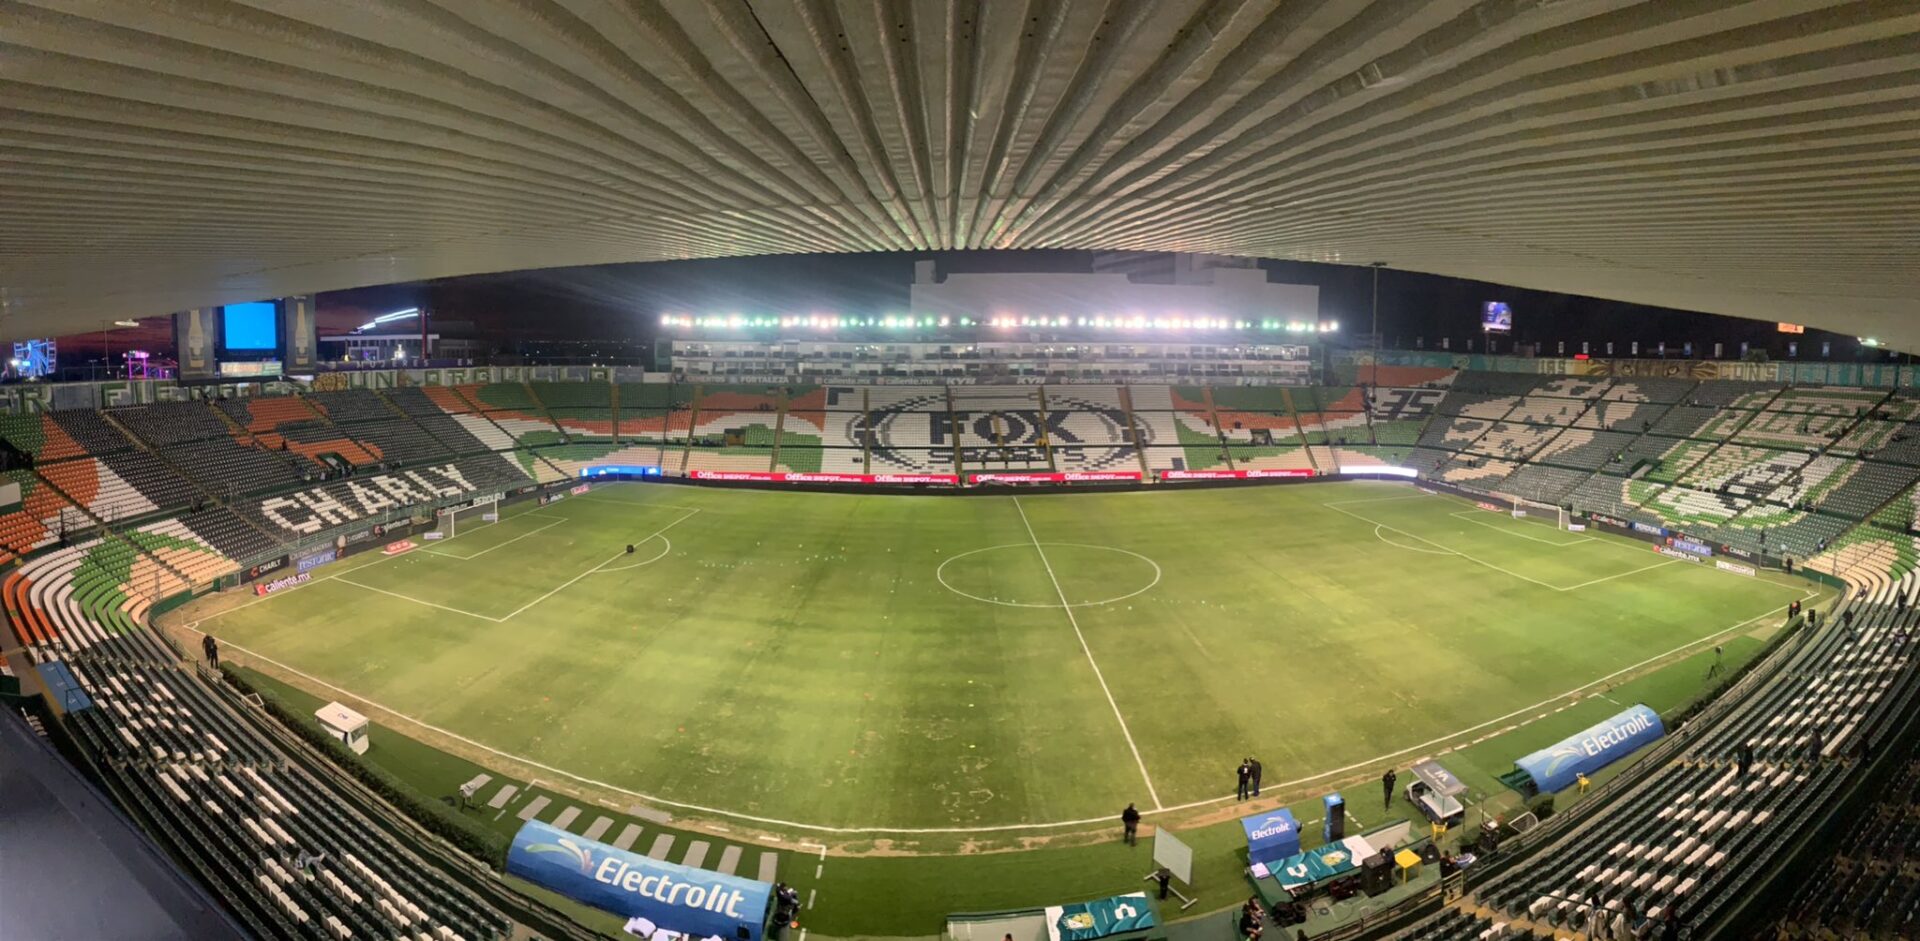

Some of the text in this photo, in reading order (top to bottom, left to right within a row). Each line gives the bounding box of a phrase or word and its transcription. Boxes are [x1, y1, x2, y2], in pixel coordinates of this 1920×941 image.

[928, 408, 1084, 444] FOX
[697, 471, 722, 480] Office
[784, 472, 811, 481] Office
[874, 473, 901, 482] Office
[1064, 472, 1089, 481] Office
[1168, 471, 1192, 479] Office
[1246, 470, 1268, 478] Office
[262, 463, 477, 534] CHARLY
[259, 559, 281, 573] CHARLY
[265, 572, 312, 593] caliente.mx
[1581, 712, 1655, 757] Electrolit
[1251, 822, 1291, 841] Electrolit
[594, 856, 745, 919] Electrolit
